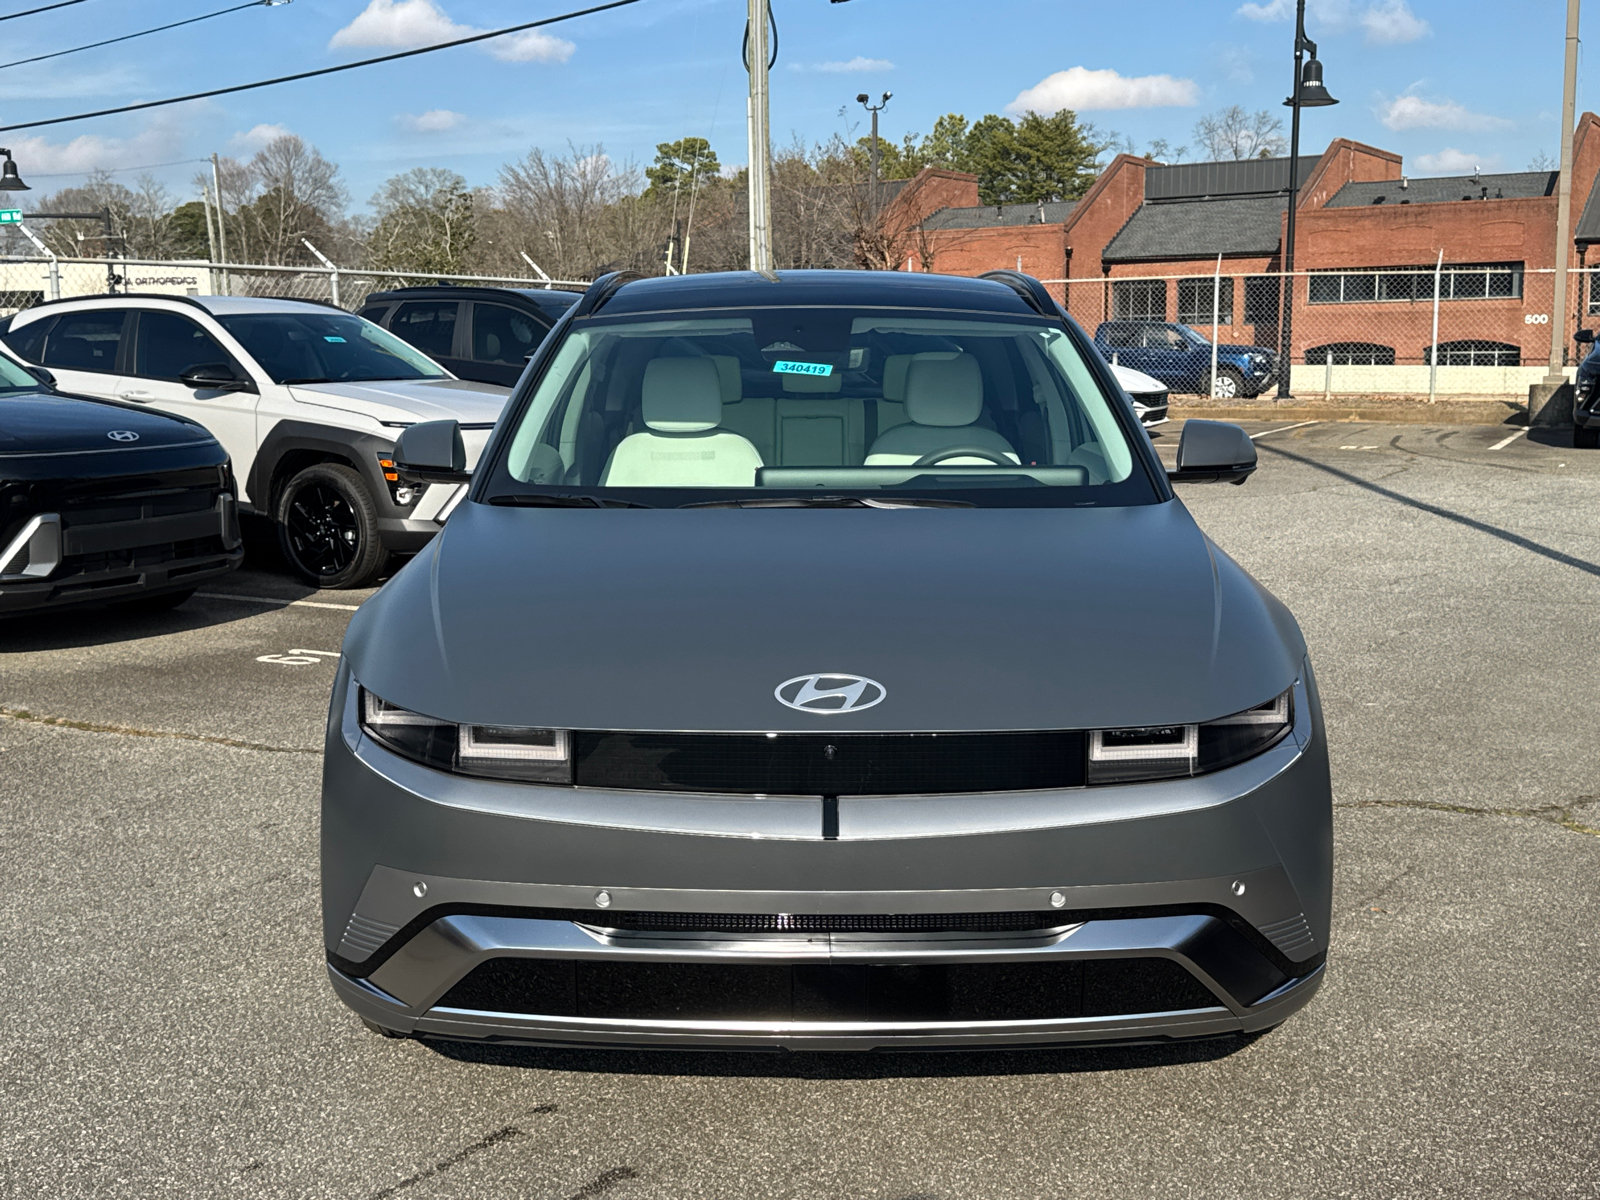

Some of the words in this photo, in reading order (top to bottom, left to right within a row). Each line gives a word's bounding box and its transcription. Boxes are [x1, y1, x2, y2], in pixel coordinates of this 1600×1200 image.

[135, 276, 198, 286] ORTHOPEDICS
[1524, 314, 1549, 325] 500
[780, 362, 826, 375] 340419
